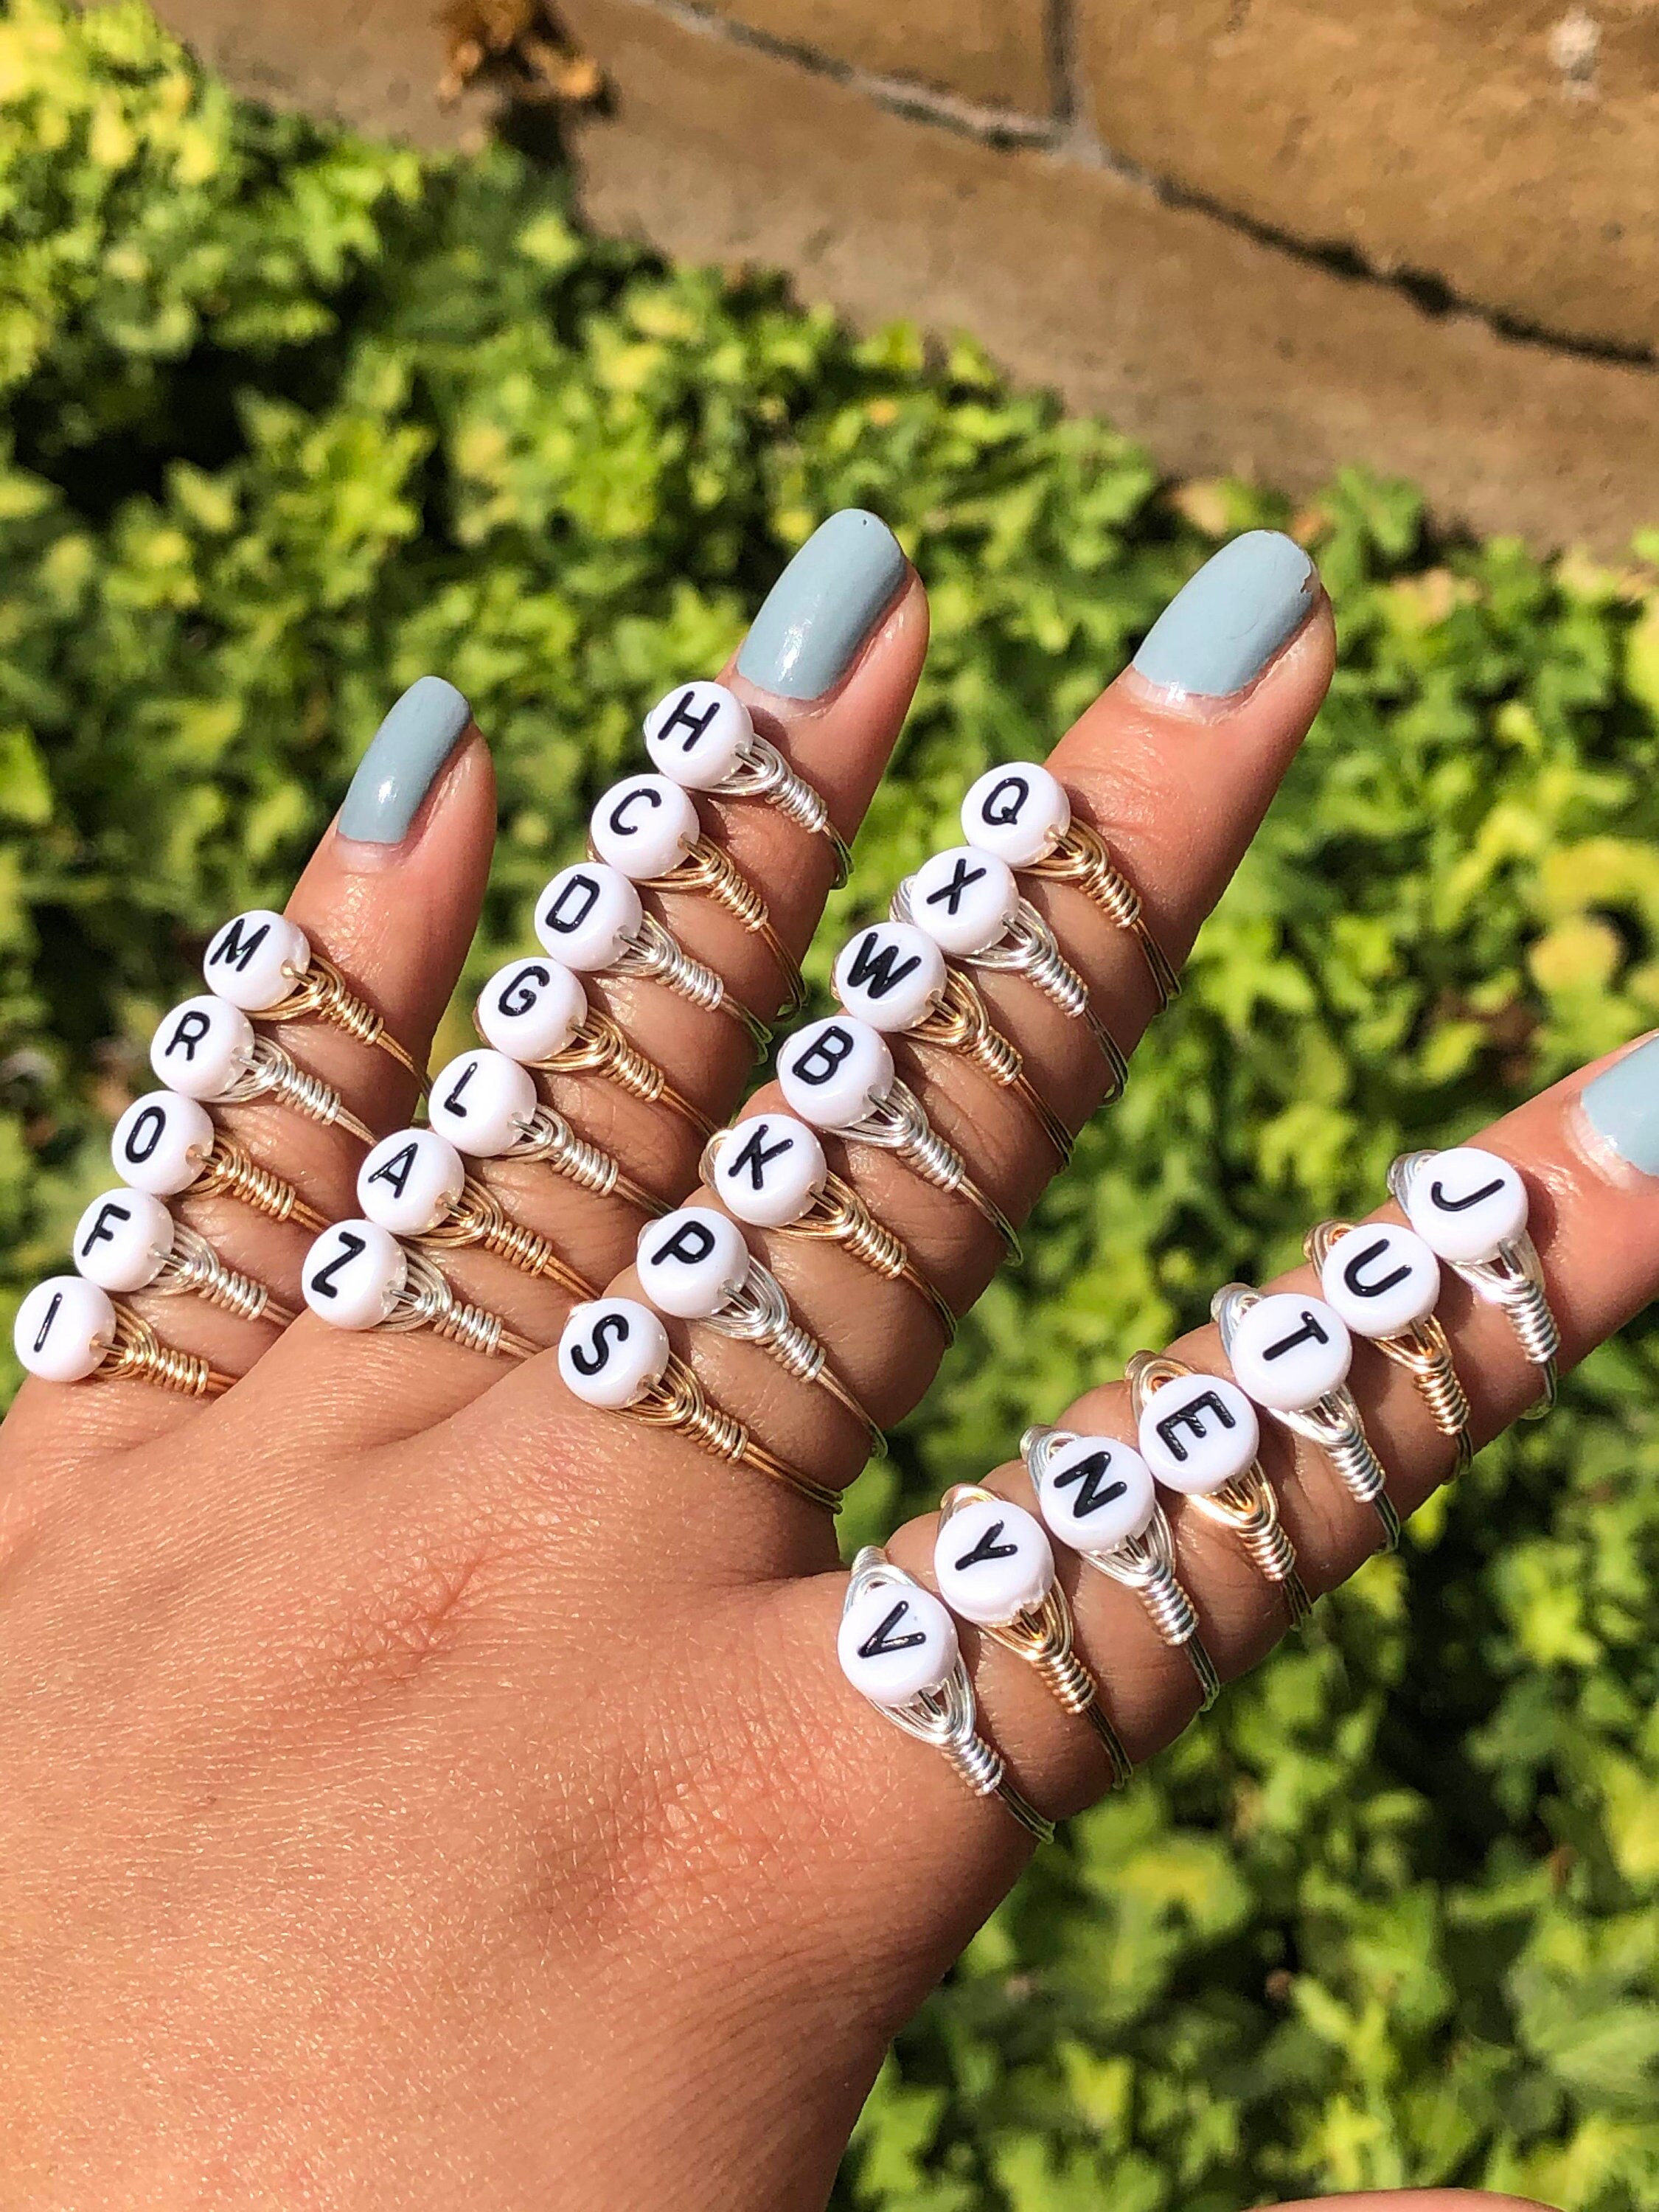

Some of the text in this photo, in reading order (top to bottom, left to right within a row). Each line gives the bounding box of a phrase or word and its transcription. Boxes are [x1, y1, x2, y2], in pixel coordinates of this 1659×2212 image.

[657, 691, 720, 752] H
[610, 788, 662, 835] C
[981, 777, 1029, 826] Q
[545, 874, 600, 933] D
[926, 858, 987, 915] X
[209, 918, 271, 972] M
[846, 932, 922, 999] W
[498, 965, 550, 1017] G
[164, 1011, 210, 1061] R
[792, 1026, 854, 1085] B
[443, 1062, 478, 1118] L
[125, 1106, 166, 1164] O
[728, 1124, 793, 1191] K
[368, 1142, 419, 1199] A
[1430, 1179, 1505, 1212] J
[81, 1203, 131, 1256] F
[650, 1220, 715, 1266] P
[310, 1231, 366, 1298] Z
[1343, 1239, 1412, 1298] U
[33, 1293, 63, 1352] I
[570, 1313, 630, 1376] S
[1262, 1311, 1329, 1361] T
[1156, 1391, 1236, 1461] E
[1053, 1451, 1127, 1518] N
[955, 1520, 1018, 1571] Y
[858, 1600, 926, 1659] V
